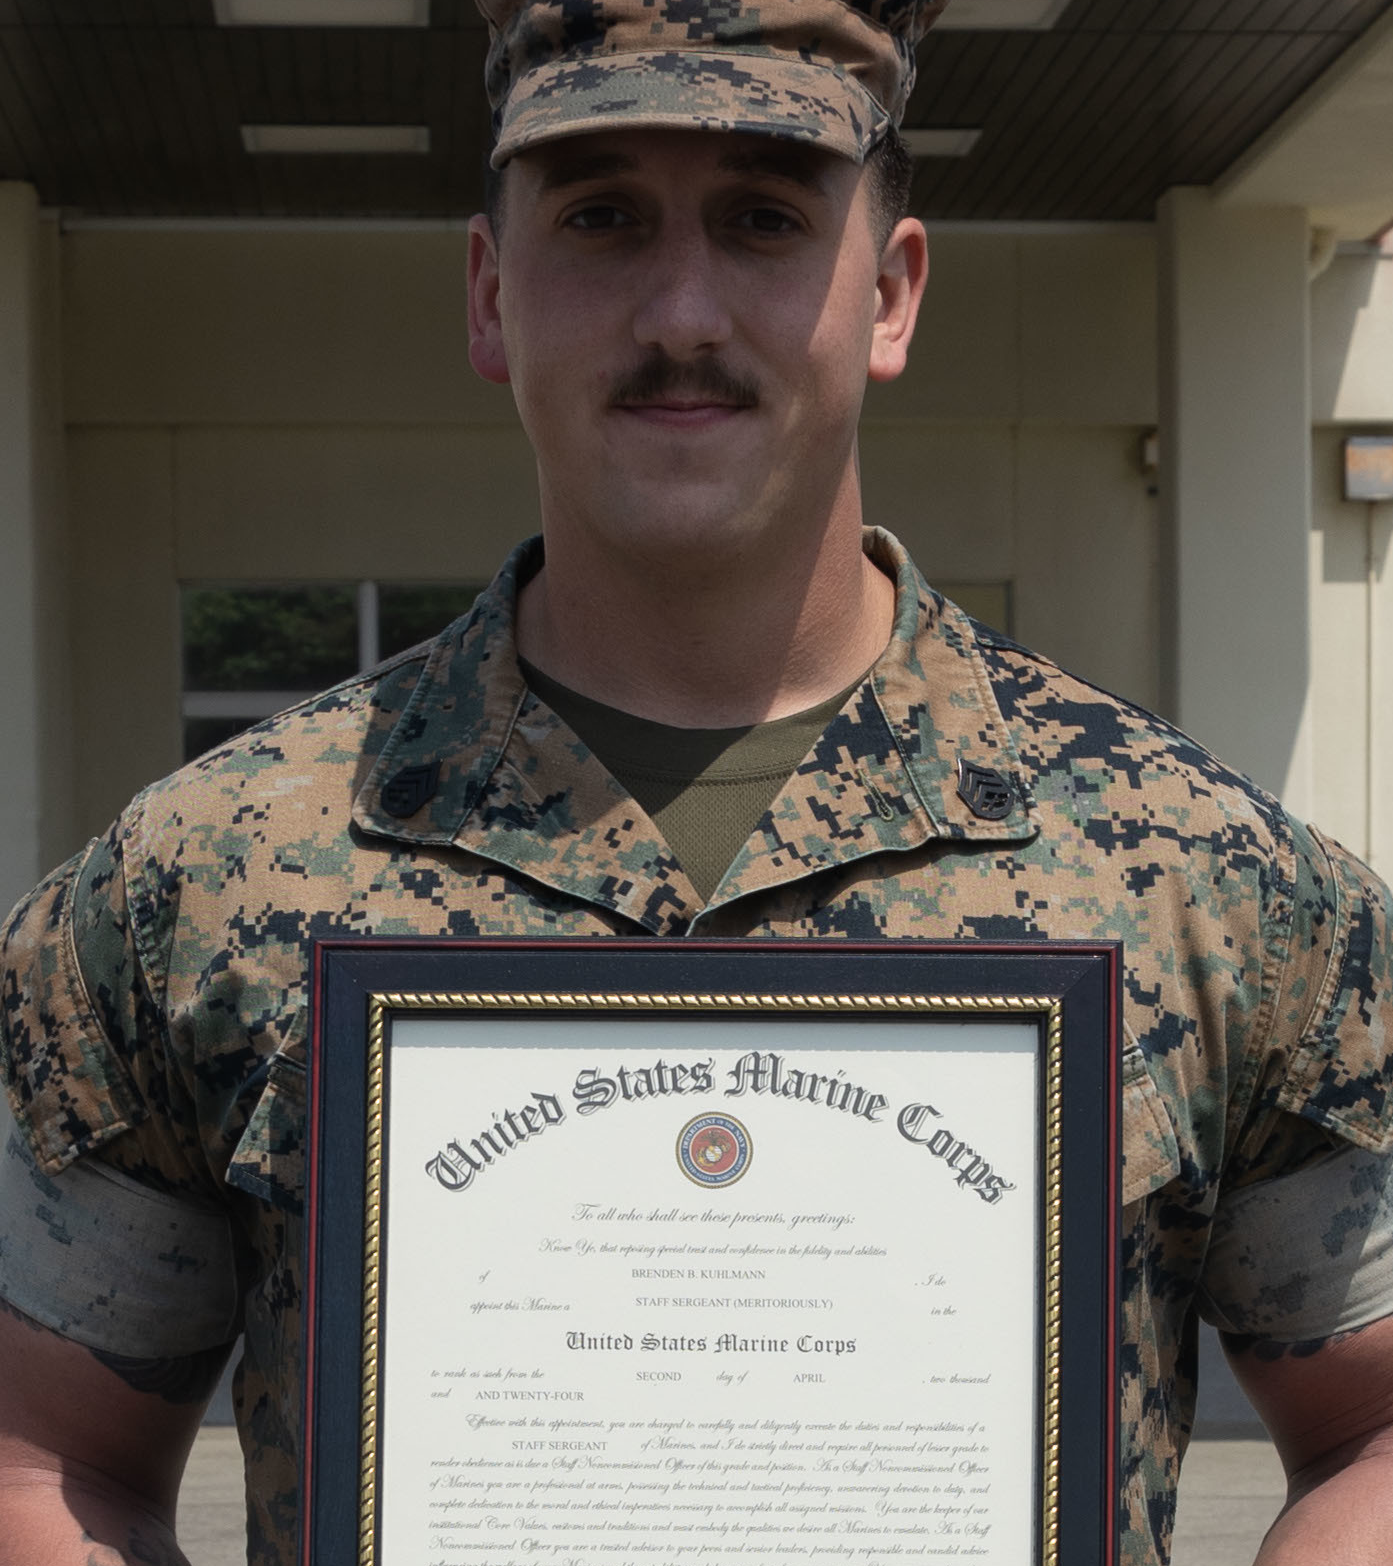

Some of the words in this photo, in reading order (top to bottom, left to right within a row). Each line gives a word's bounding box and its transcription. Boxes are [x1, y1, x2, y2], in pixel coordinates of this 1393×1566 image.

[425, 1091, 566, 1192] United
[572, 1057, 715, 1116] States
[724, 1051, 889, 1123] Marine
[897, 1102, 1016, 1205] Corps
[571, 1203, 598, 1222] To
[597, 1207, 617, 1221] all
[617, 1207, 643, 1221] who
[646, 1208, 680, 1222] shall
[679, 1212, 698, 1222] see
[700, 1208, 731, 1222] these
[728, 1212, 786, 1229] presents,
[786, 1213, 856, 1231] greetings:
[478, 1270, 491, 1284] of
[631, 1269, 684, 1279] BRENDEN
[687, 1269, 698, 1279] B.
[700, 1269, 766, 1280] KUHLMANN
[470, 1301, 503, 1314] appoint
[504, 1300, 519, 1311] this
[522, 1298, 563, 1311] Marine
[635, 1297, 669, 1307] STAFF
[672, 1297, 729, 1308] SERGEANT
[733, 1298, 833, 1310] (MERITORIOUSLY)
[930, 1307, 941, 1315] in
[942, 1305, 957, 1315] the
[566, 1331, 633, 1351] United
[640, 1333, 707, 1352] States
[713, 1333, 789, 1354] Marine
[796, 1334, 856, 1356] Corps
[636, 1372, 682, 1382] SECOND
[793, 1373, 826, 1383] APRIL
[475, 1391, 500, 1400] AND
[503, 1391, 584, 1401] TWENTY-FOUR
[511, 1440, 545, 1451] STAFF
[548, 1440, 608, 1451] SERGEANT
